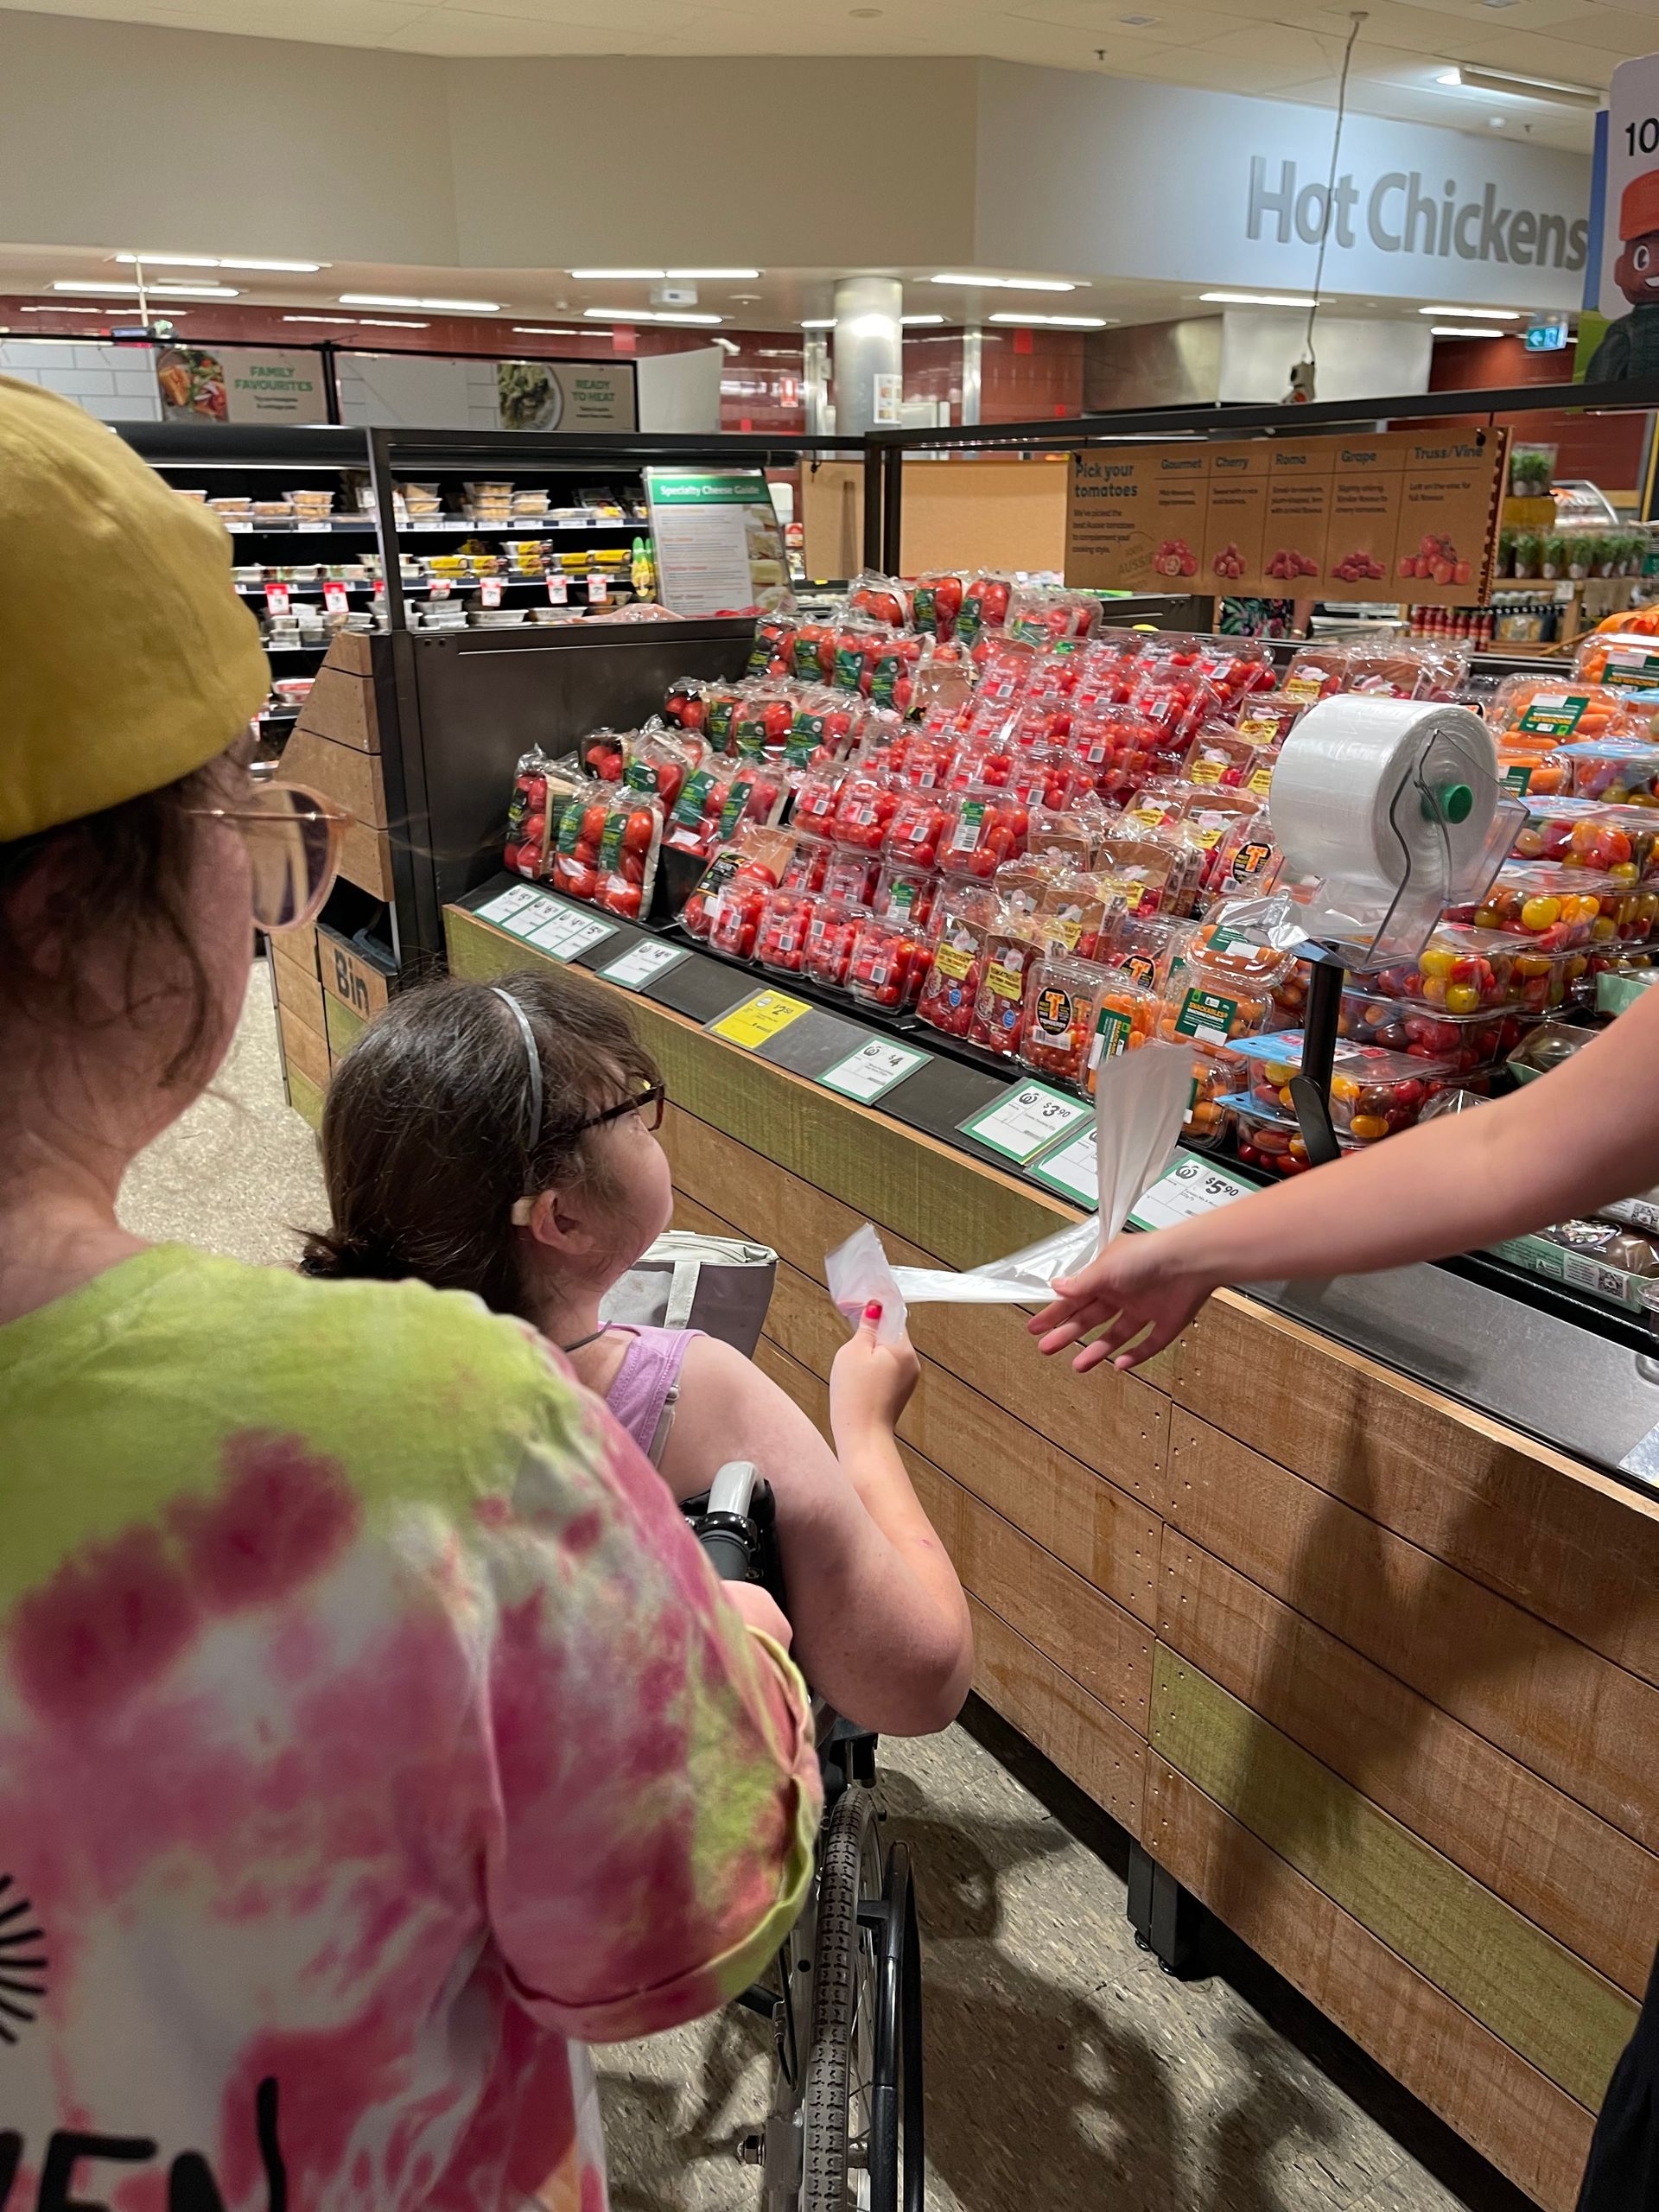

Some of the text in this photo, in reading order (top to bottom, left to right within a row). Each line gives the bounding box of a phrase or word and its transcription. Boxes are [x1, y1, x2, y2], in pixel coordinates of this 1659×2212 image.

[1246, 156, 1590, 271] Hot Chickens
[250, 365, 296, 378] FAMILY
[234, 378, 313, 392] FAVOURITES
[575, 379, 611, 390] READY
[572, 391, 587, 402] TO
[1160, 458, 1202, 470] Gourmet
[1215, 456, 1249, 470] Cherry
[1275, 454, 1306, 465] Roma
[1341, 450, 1377, 465] Grape
[1075, 462, 1134, 481] Pick your
[659, 485, 701, 497] Specialty
[1074, 484, 1138, 498] tomatoes
[334, 948, 370, 1018] Bin
[888, 1054, 904, 1067] $4
